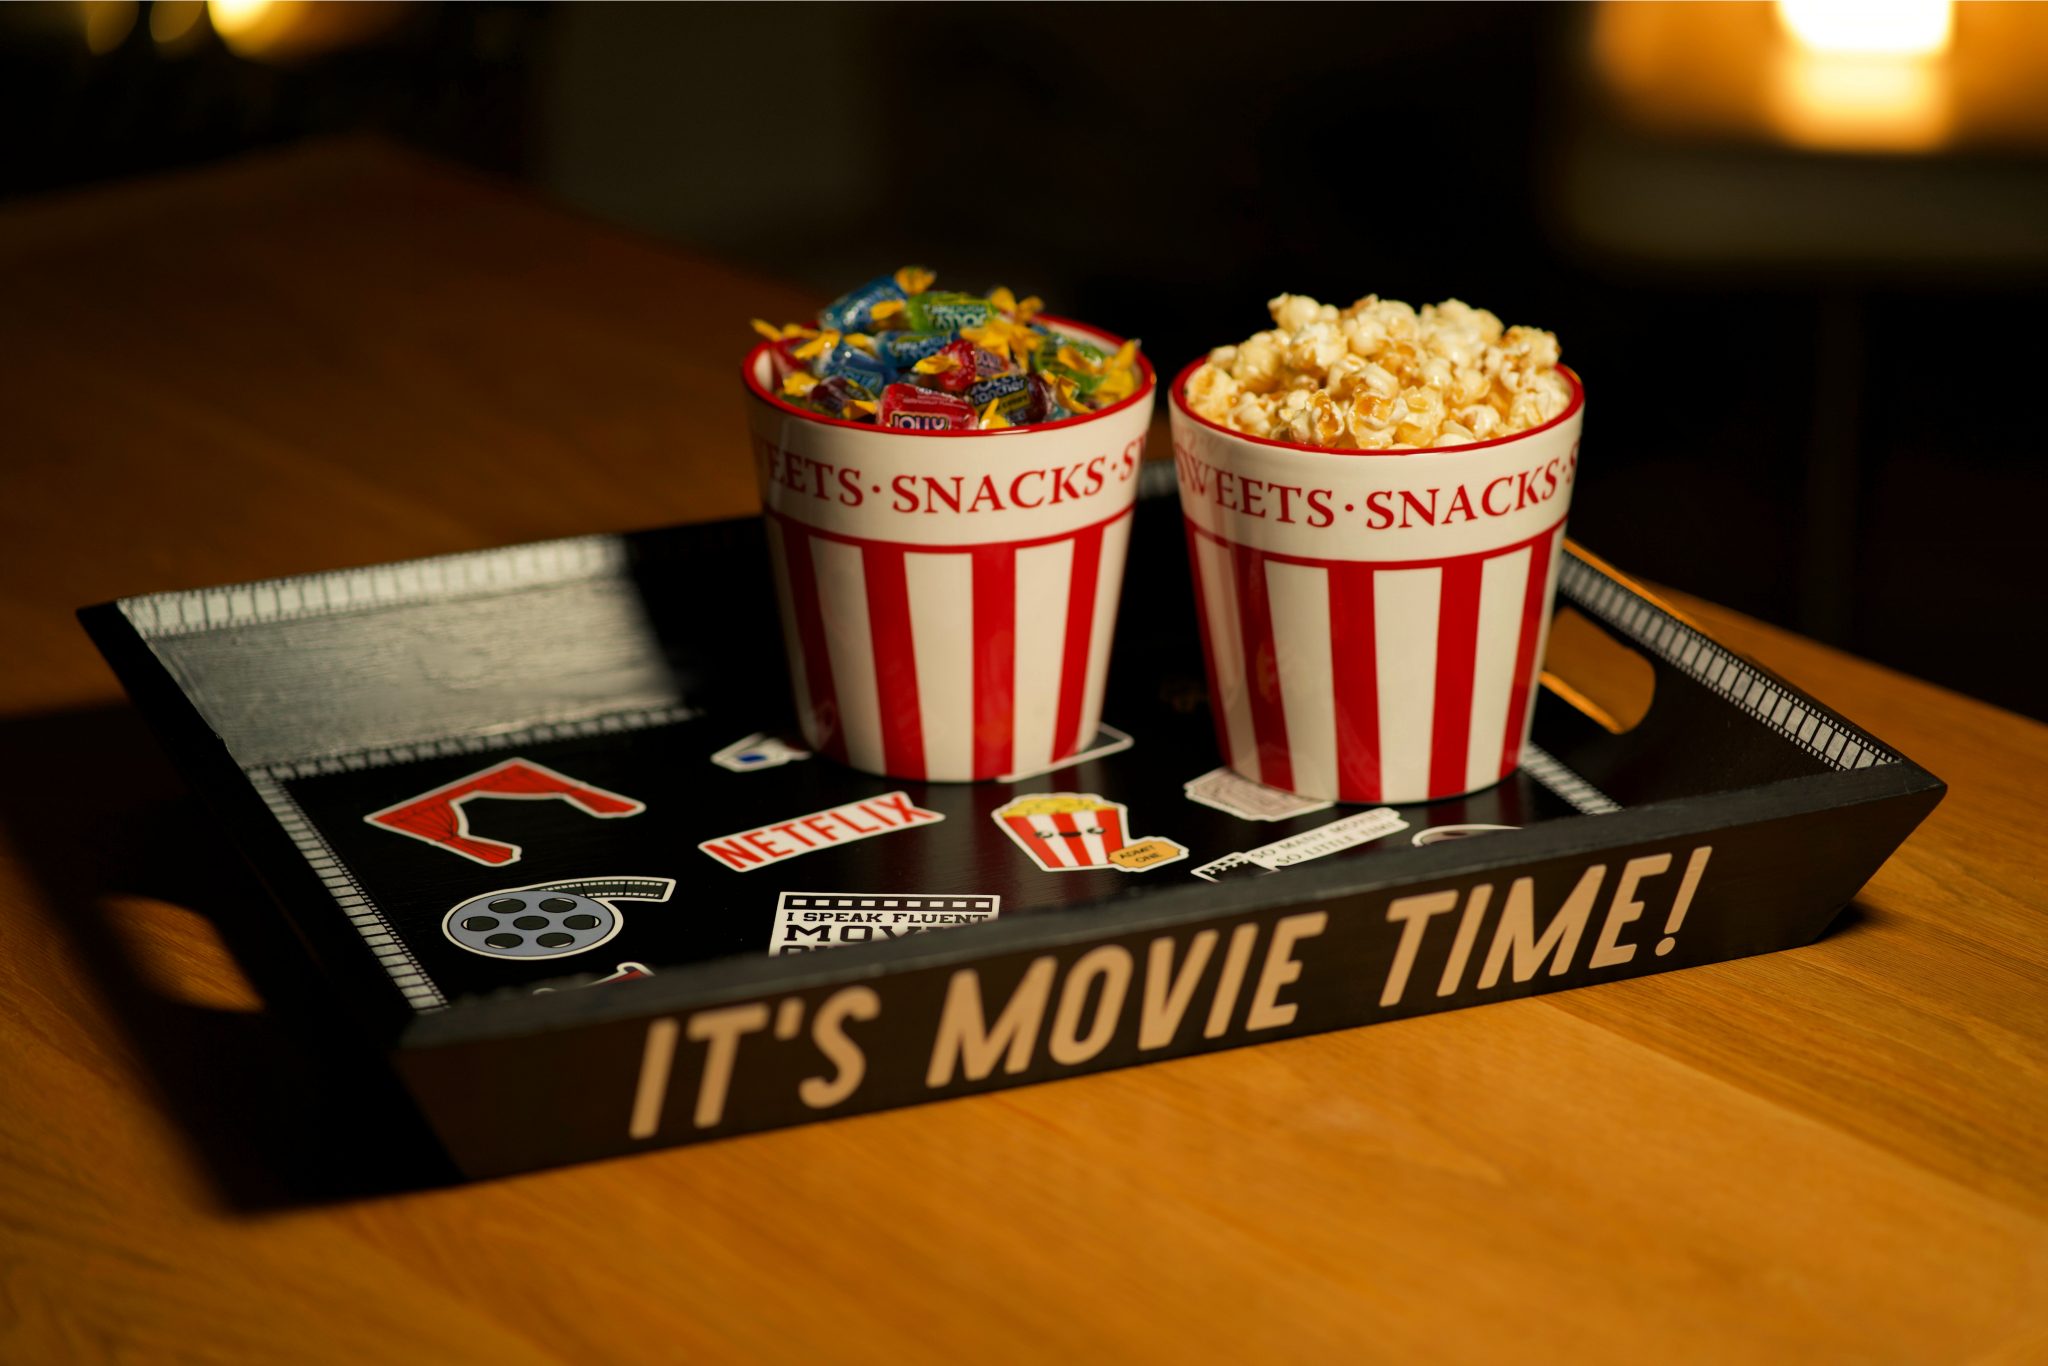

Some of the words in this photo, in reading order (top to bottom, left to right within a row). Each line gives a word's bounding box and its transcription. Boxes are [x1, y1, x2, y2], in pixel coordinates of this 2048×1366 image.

[765, 441, 864, 507] EETS
[892, 456, 1107, 515] SNACKS
[1365, 457, 1561, 530] SNACKS
[703, 795, 936, 869] NETFLIX
[786, 911, 795, 922] I
[803, 912, 884, 923] SPEAK
[892, 913, 989, 925] FLUENT
[629, 987, 881, 1140] IT'S
[925, 911, 1328, 1089] MOVIE
[1379, 845, 1713, 1007] TIME!
